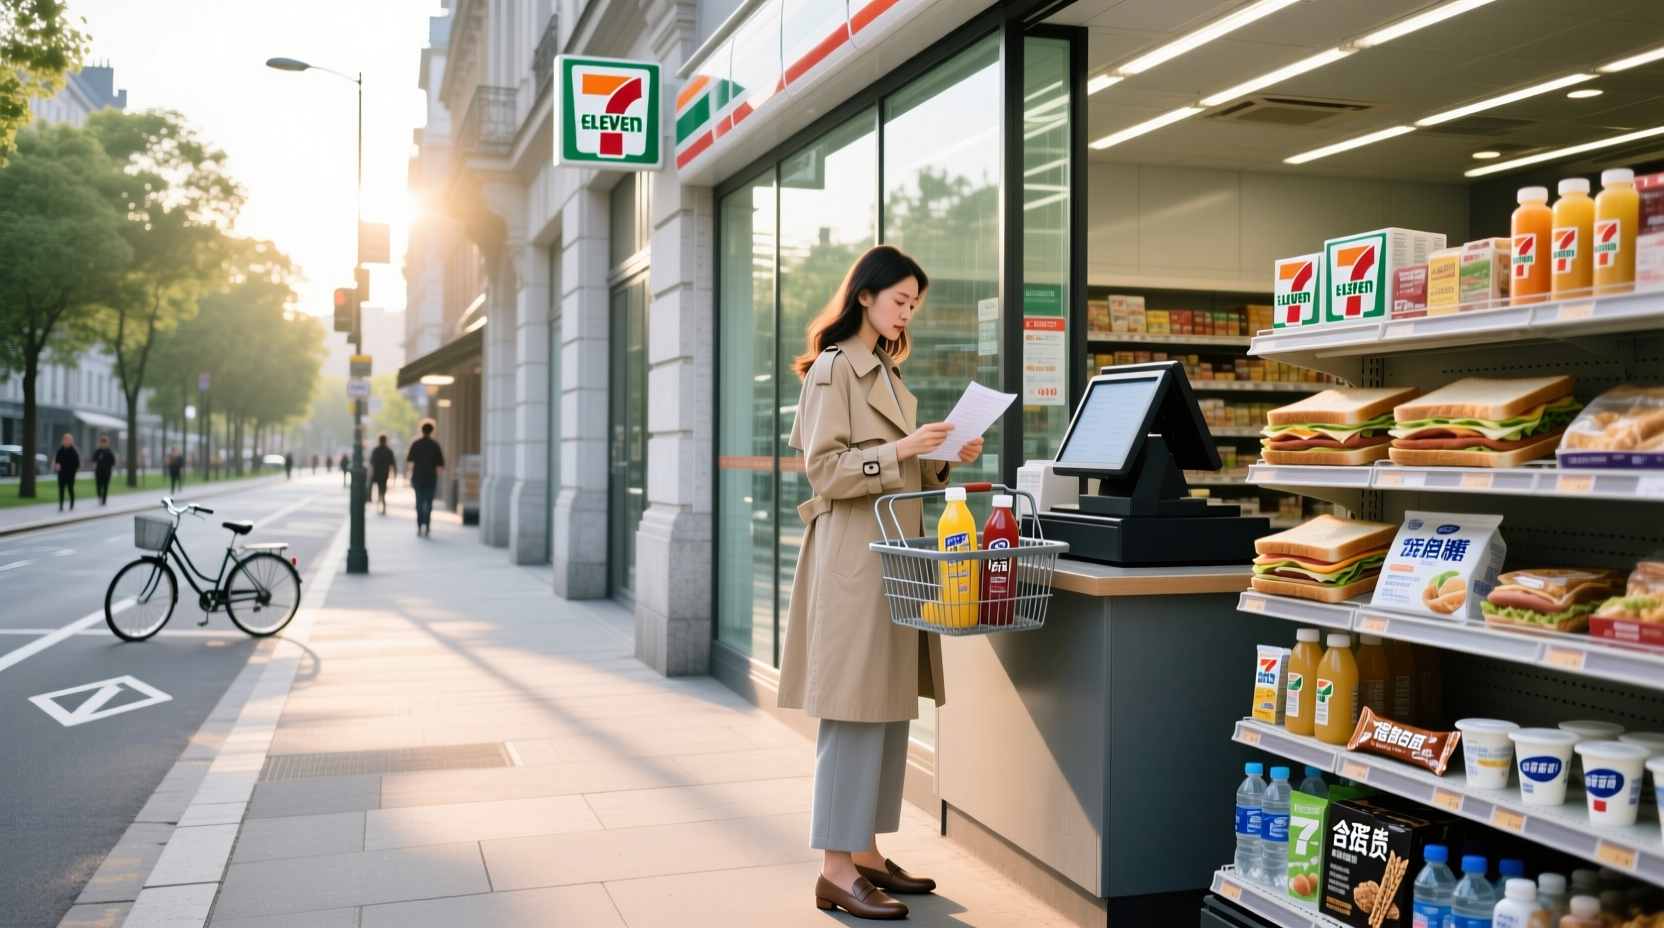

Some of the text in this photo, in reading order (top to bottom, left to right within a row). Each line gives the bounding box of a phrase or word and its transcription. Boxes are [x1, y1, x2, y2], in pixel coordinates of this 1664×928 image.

[582, 73, 642, 155] 7
[1279, 261, 1312, 323] 7
[1337, 245, 1375, 316] 7
[1290, 816, 1319, 855] 7
